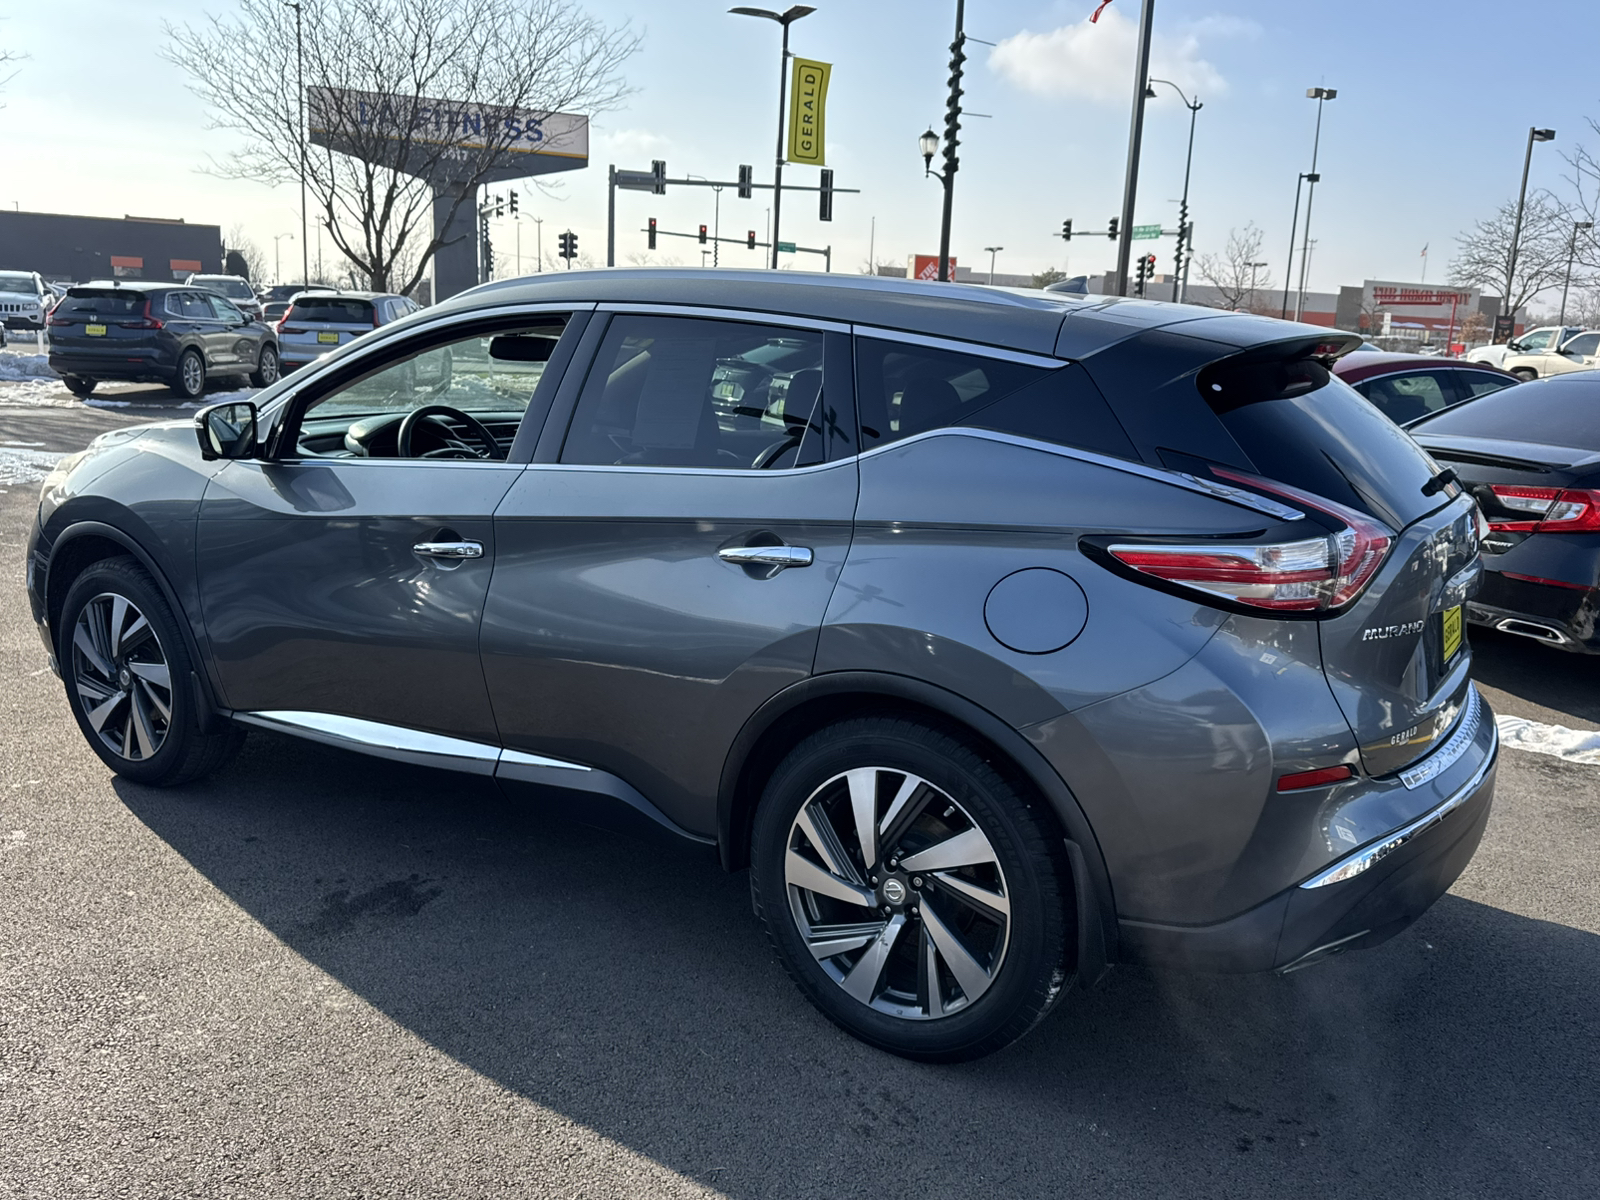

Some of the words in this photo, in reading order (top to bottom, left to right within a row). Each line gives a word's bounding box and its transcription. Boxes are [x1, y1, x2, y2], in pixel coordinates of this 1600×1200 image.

[416, 106, 544, 142] FITNESS
[801, 74, 816, 151] GERALD
[1362, 620, 1425, 641] MURANO
[1445, 616, 1460, 644] GERALD
[1390, 725, 1418, 746] GERALD
